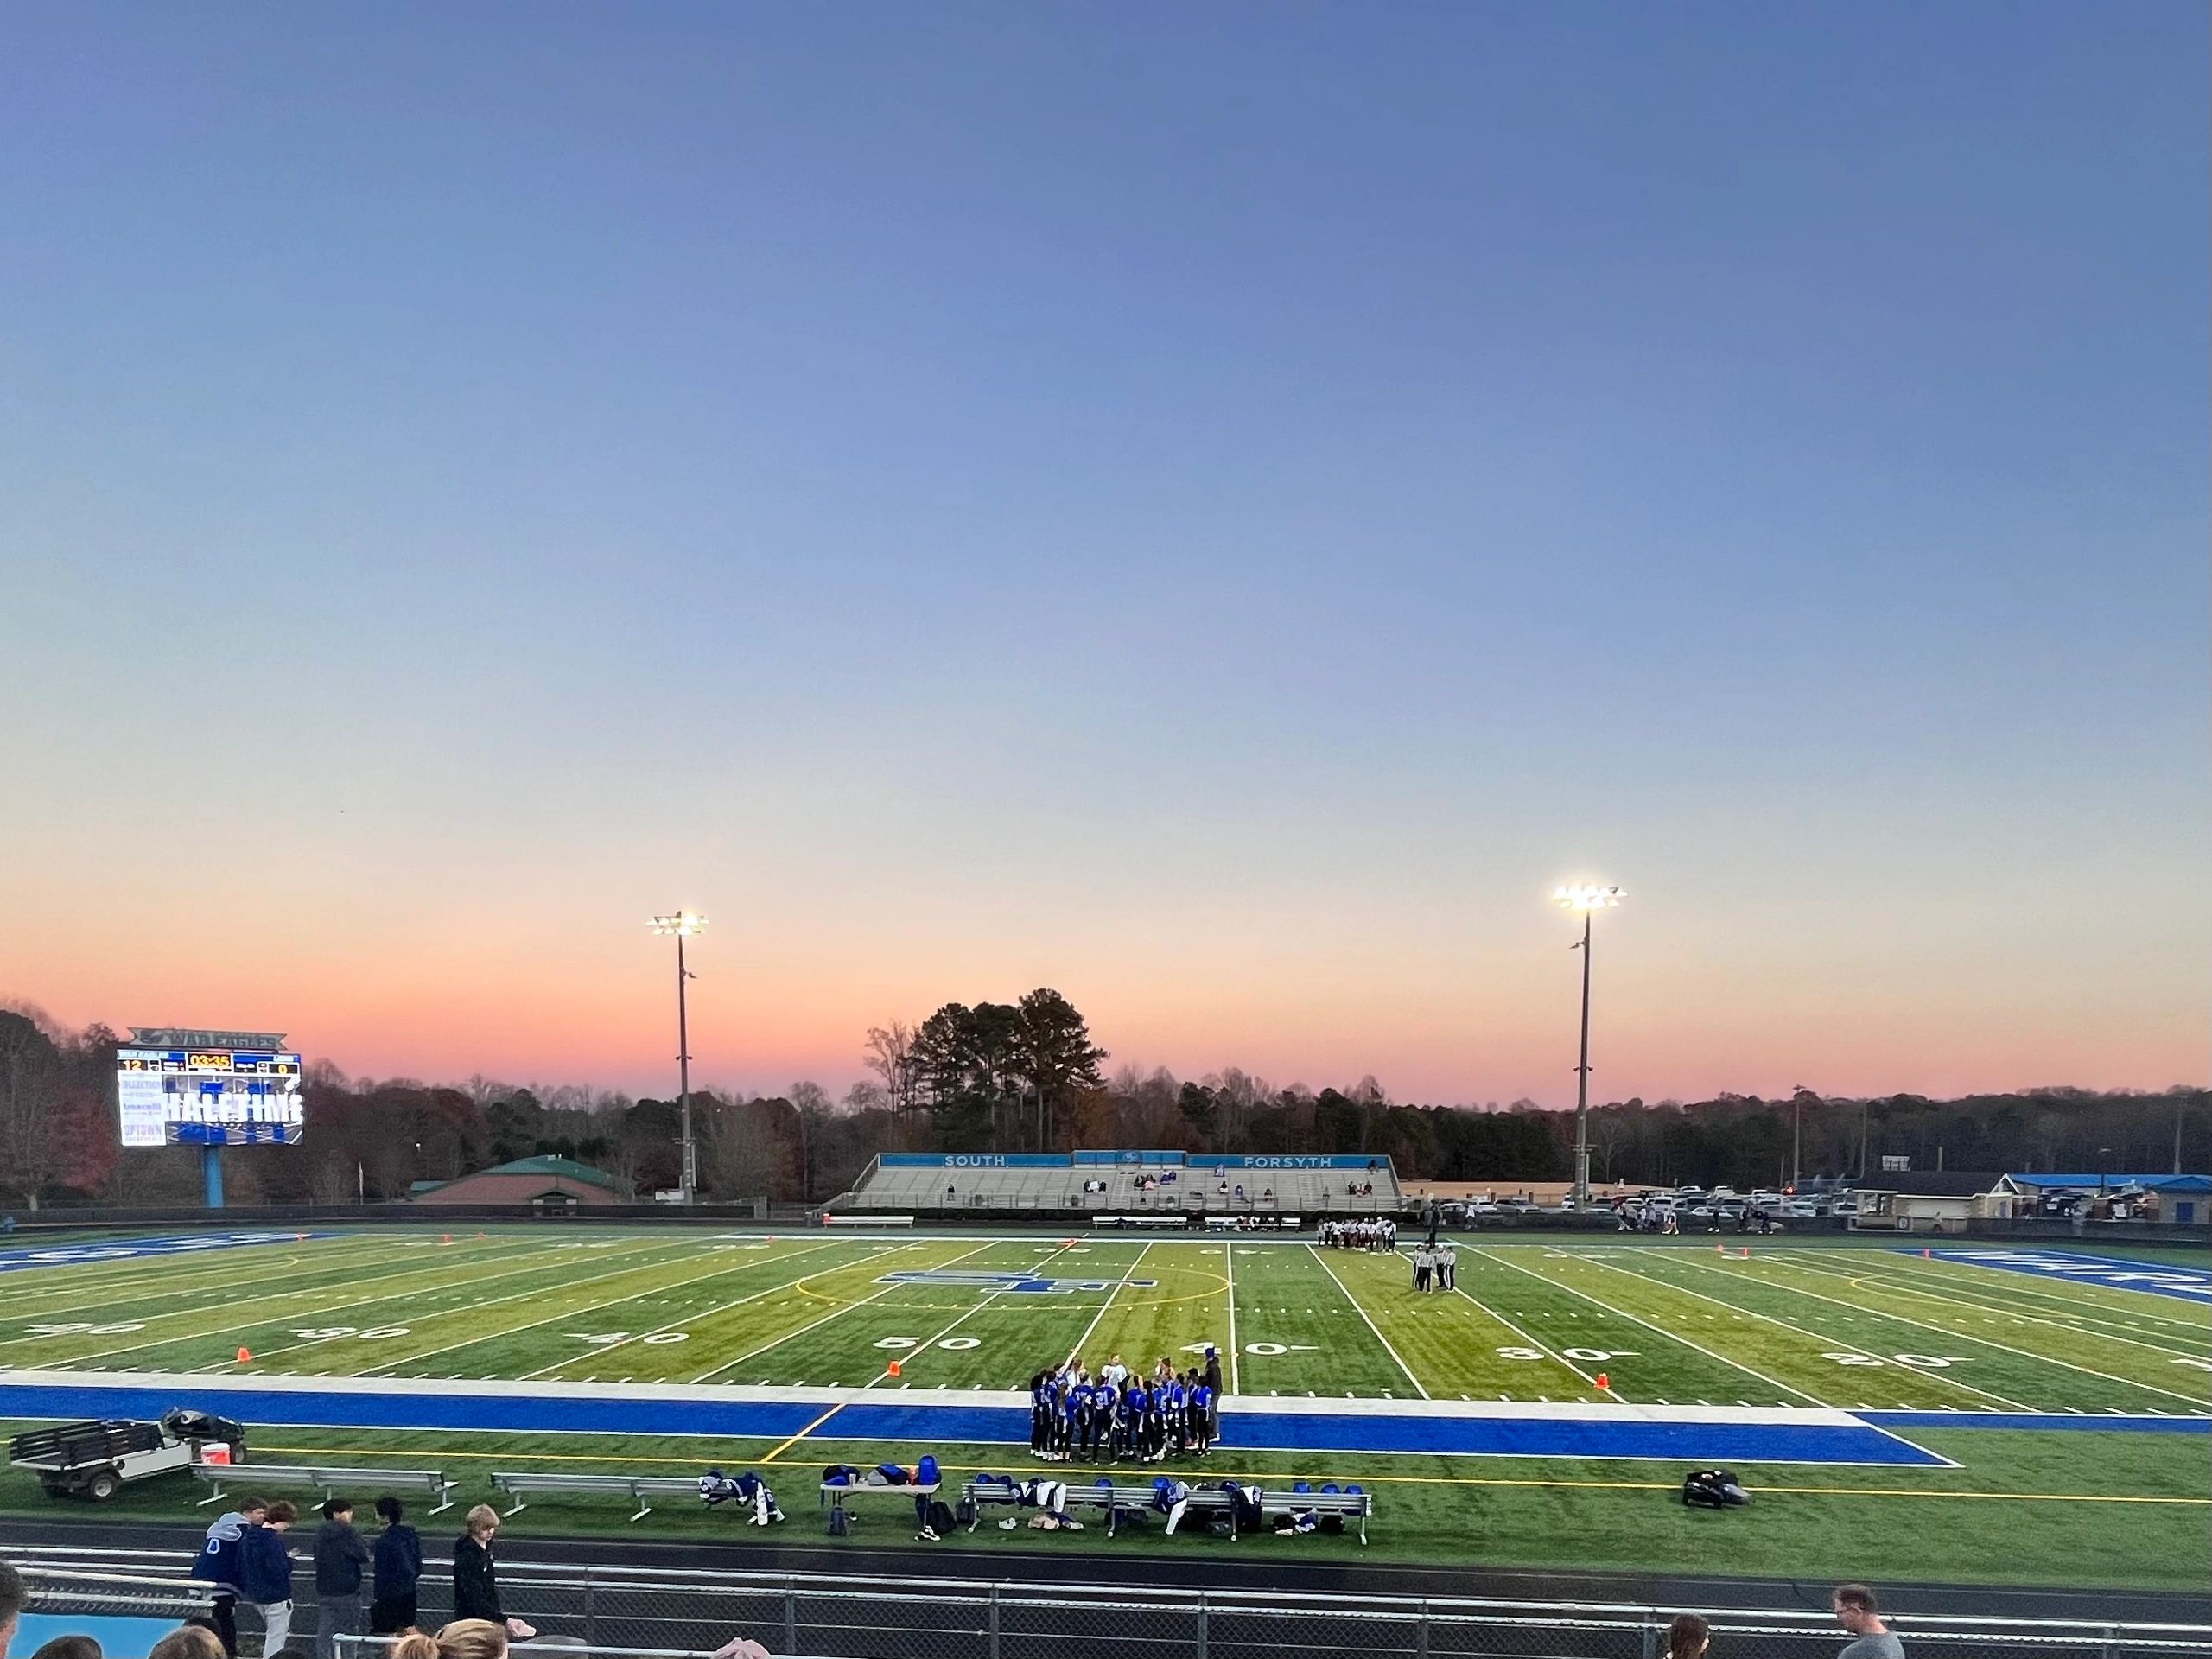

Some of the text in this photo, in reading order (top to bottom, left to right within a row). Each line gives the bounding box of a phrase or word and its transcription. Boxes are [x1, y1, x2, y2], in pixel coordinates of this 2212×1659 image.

[171, 1031, 276, 1048] WAR EAGLES
[123, 1060, 142, 1071] 12
[190, 1055, 229, 1067] 03:35
[277, 1065, 288, 1075] 0
[944, 1155, 1005, 1166] SOUTH
[1244, 1156, 1331, 1168] FORSYTH
[296, 1327, 410, 1338] 30
[582, 1332, 690, 1344] 40
[872, 1336, 982, 1349] 50
[1179, 1342, 1288, 1355] 40
[1495, 1346, 1612, 1361] 30
[1821, 1353, 1951, 1367] 20
